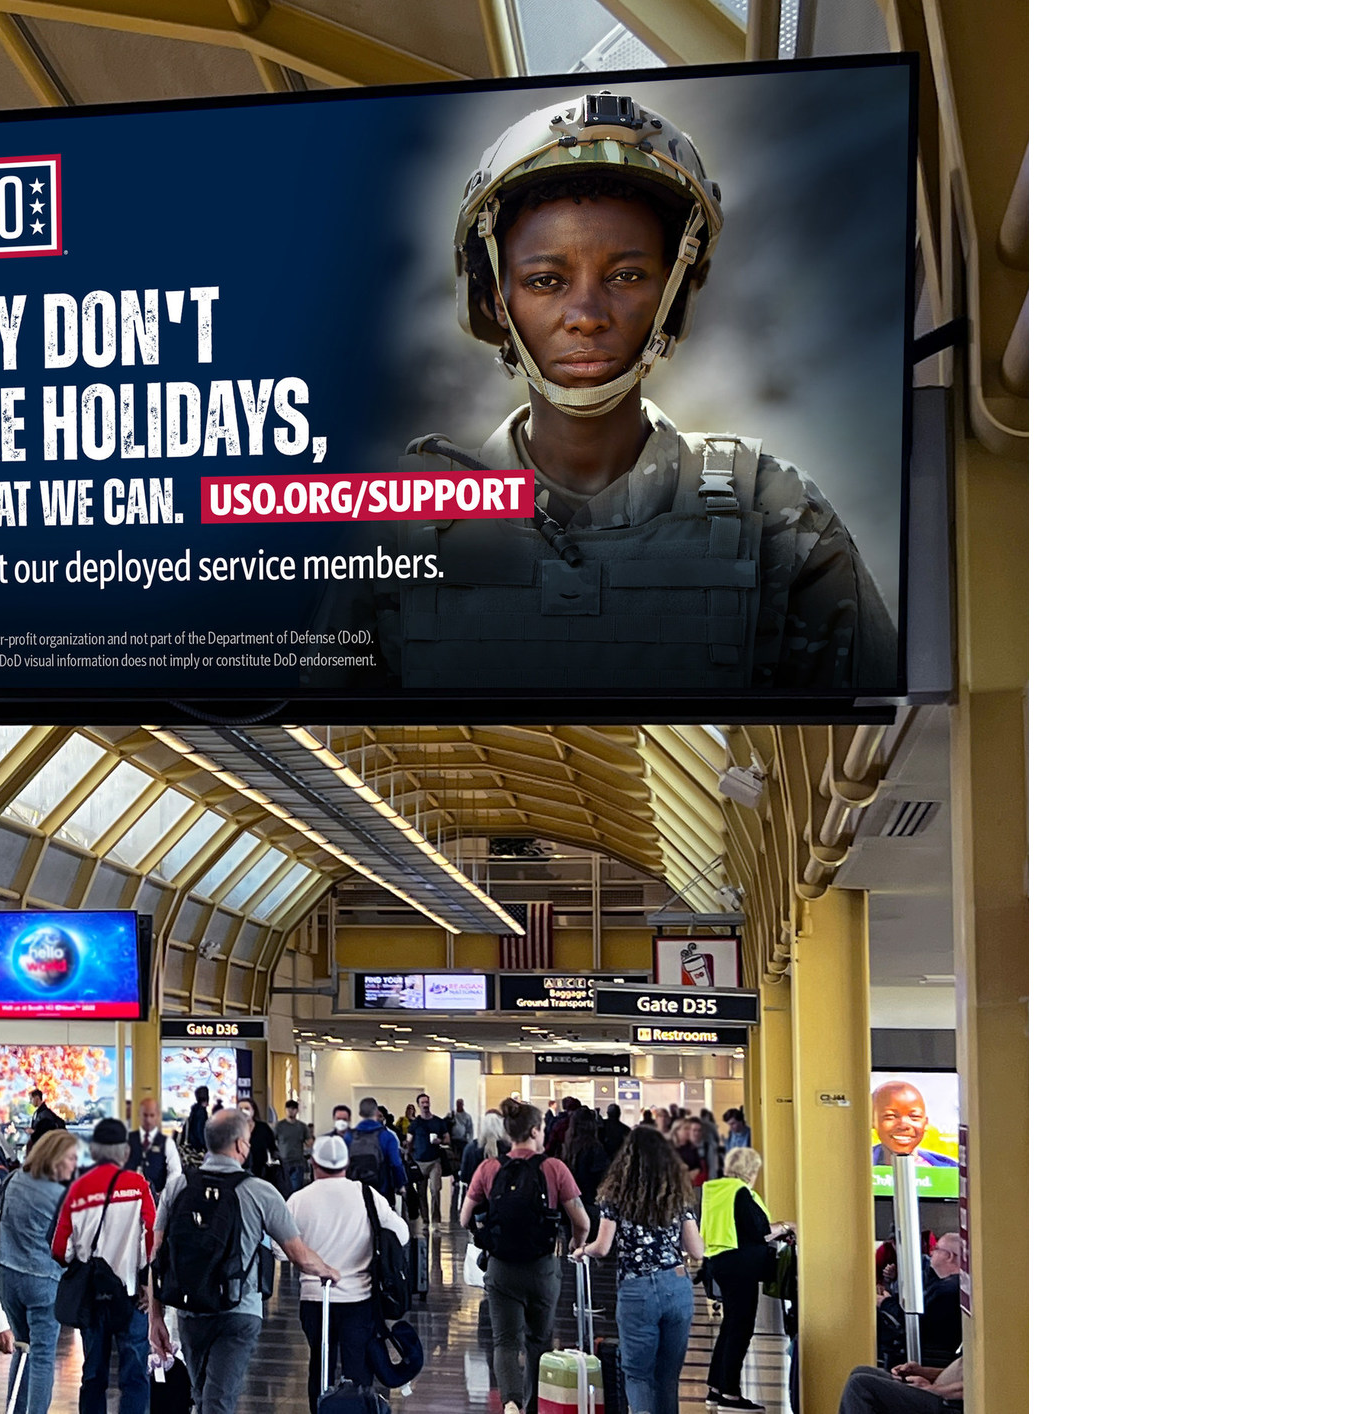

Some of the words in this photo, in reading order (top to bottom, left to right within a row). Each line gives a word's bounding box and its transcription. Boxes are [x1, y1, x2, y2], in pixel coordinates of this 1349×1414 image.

[43, 286, 220, 369] DON'T
[42, 376, 327, 464] HOLIDAYS,
[39, 479, 94, 526] WE
[103, 477, 184, 526] CAN.
[210, 477, 526, 519] USO.ORG/SUPPORT
[14, 559, 59, 584] our
[65, 548, 191, 590] deployed
[198, 548, 296, 582] service
[303, 545, 444, 580] members.
[38, 632, 106, 649] organization
[107, 631, 128, 645] and
[129, 632, 149, 645] not
[150, 632, 173, 648] part
[174, 630, 186, 645] of
[187, 630, 206, 645] the
[207, 630, 274, 648] Department
[276, 630, 288, 645] of
[290, 629, 336, 645] Defense
[337, 629, 375, 646] (DoD).
[0, 653, 22, 668] DoD
[23, 653, 55, 667] visual
[56, 653, 119, 667] information
[120, 652, 147, 667] does
[148, 654, 168, 667] not
[169, 652, 201, 670] imply
[202, 656, 214, 667] or
[215, 653, 271, 667] constitute
[273, 652, 298, 667] DoD
[299, 652, 378, 667] endorsement.
[29, 943, 64, 959] hello
[549, 988, 587, 999] Baggage
[516, 998, 549, 1008] Ground
[549, 998, 594, 1009] Transporta
[636, 996, 679, 1013] Gate
[682, 998, 718, 1015] D35
[186, 1023, 214, 1035] Gate
[215, 1023, 239, 1036] D36
[652, 1028, 718, 1042] Restrooms
